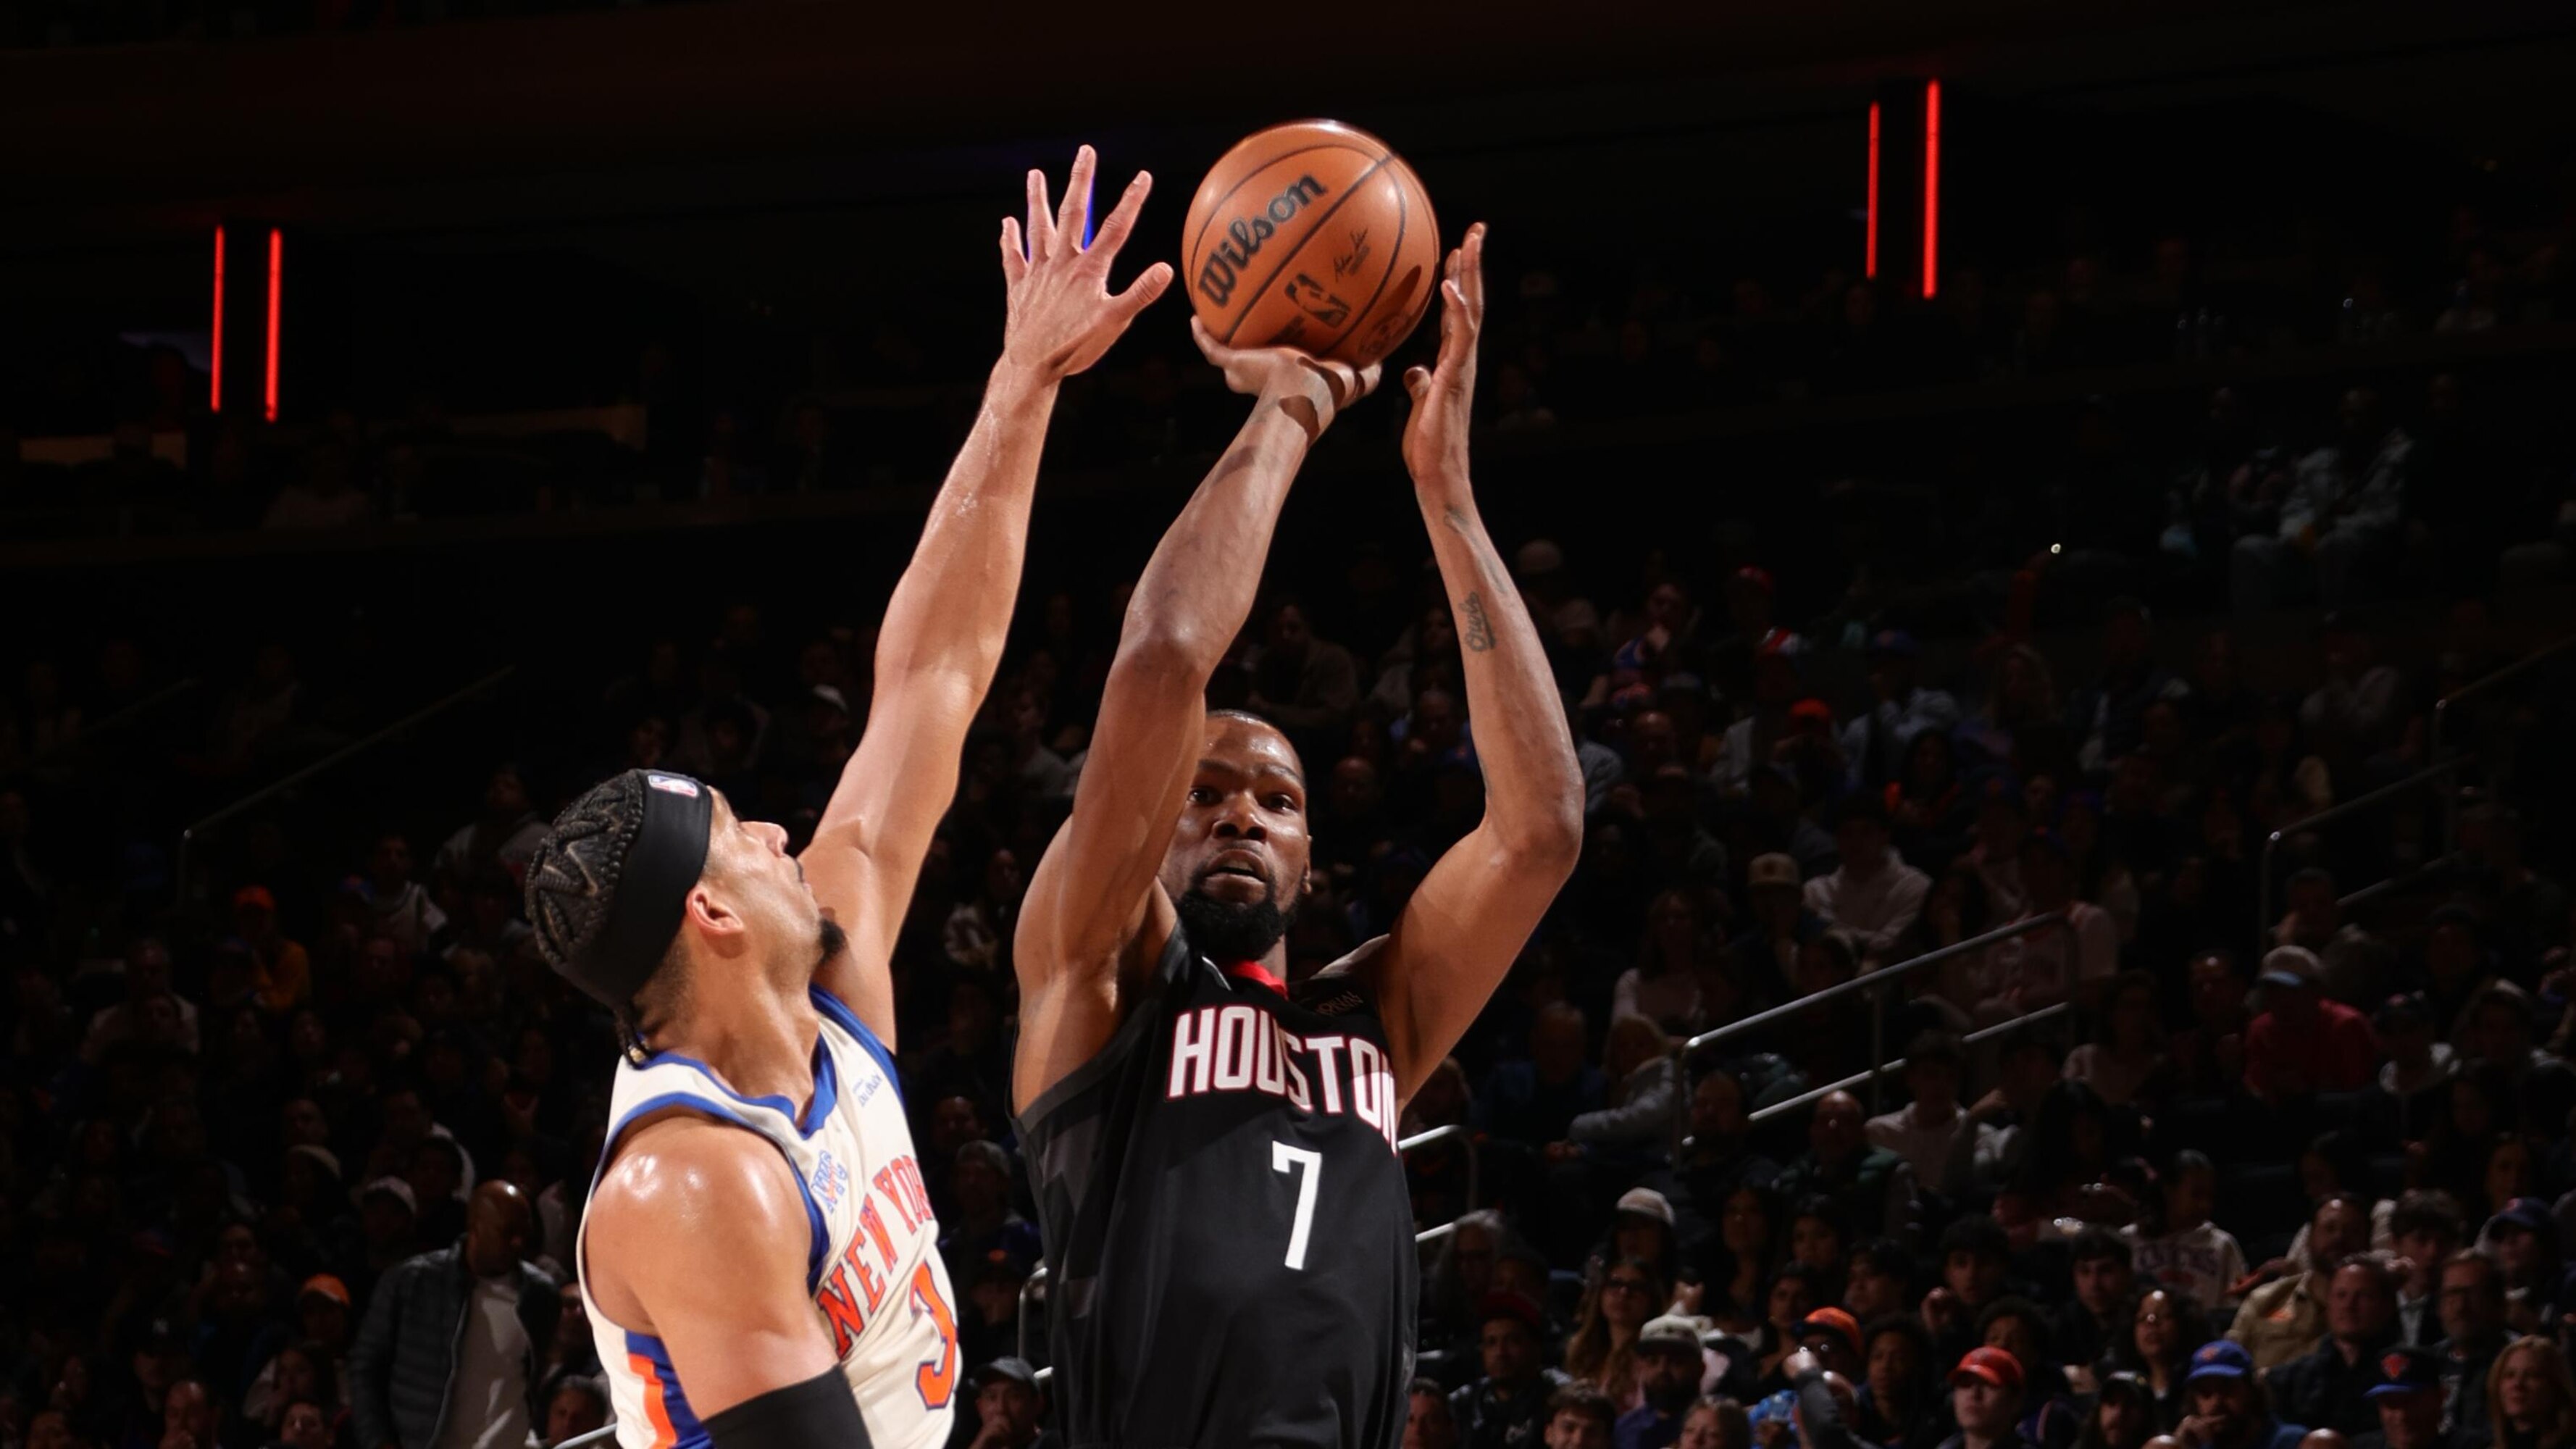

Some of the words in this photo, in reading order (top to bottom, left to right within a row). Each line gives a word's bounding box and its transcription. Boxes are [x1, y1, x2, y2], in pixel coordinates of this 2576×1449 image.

[1199, 175, 1326, 307] Wilson
[1166, 1004, 1398, 1158] HOUSTON
[816, 1193, 898, 1361] NEW
[872, 1154, 933, 1235] YOR
[1271, 1140, 1322, 1271] 7
